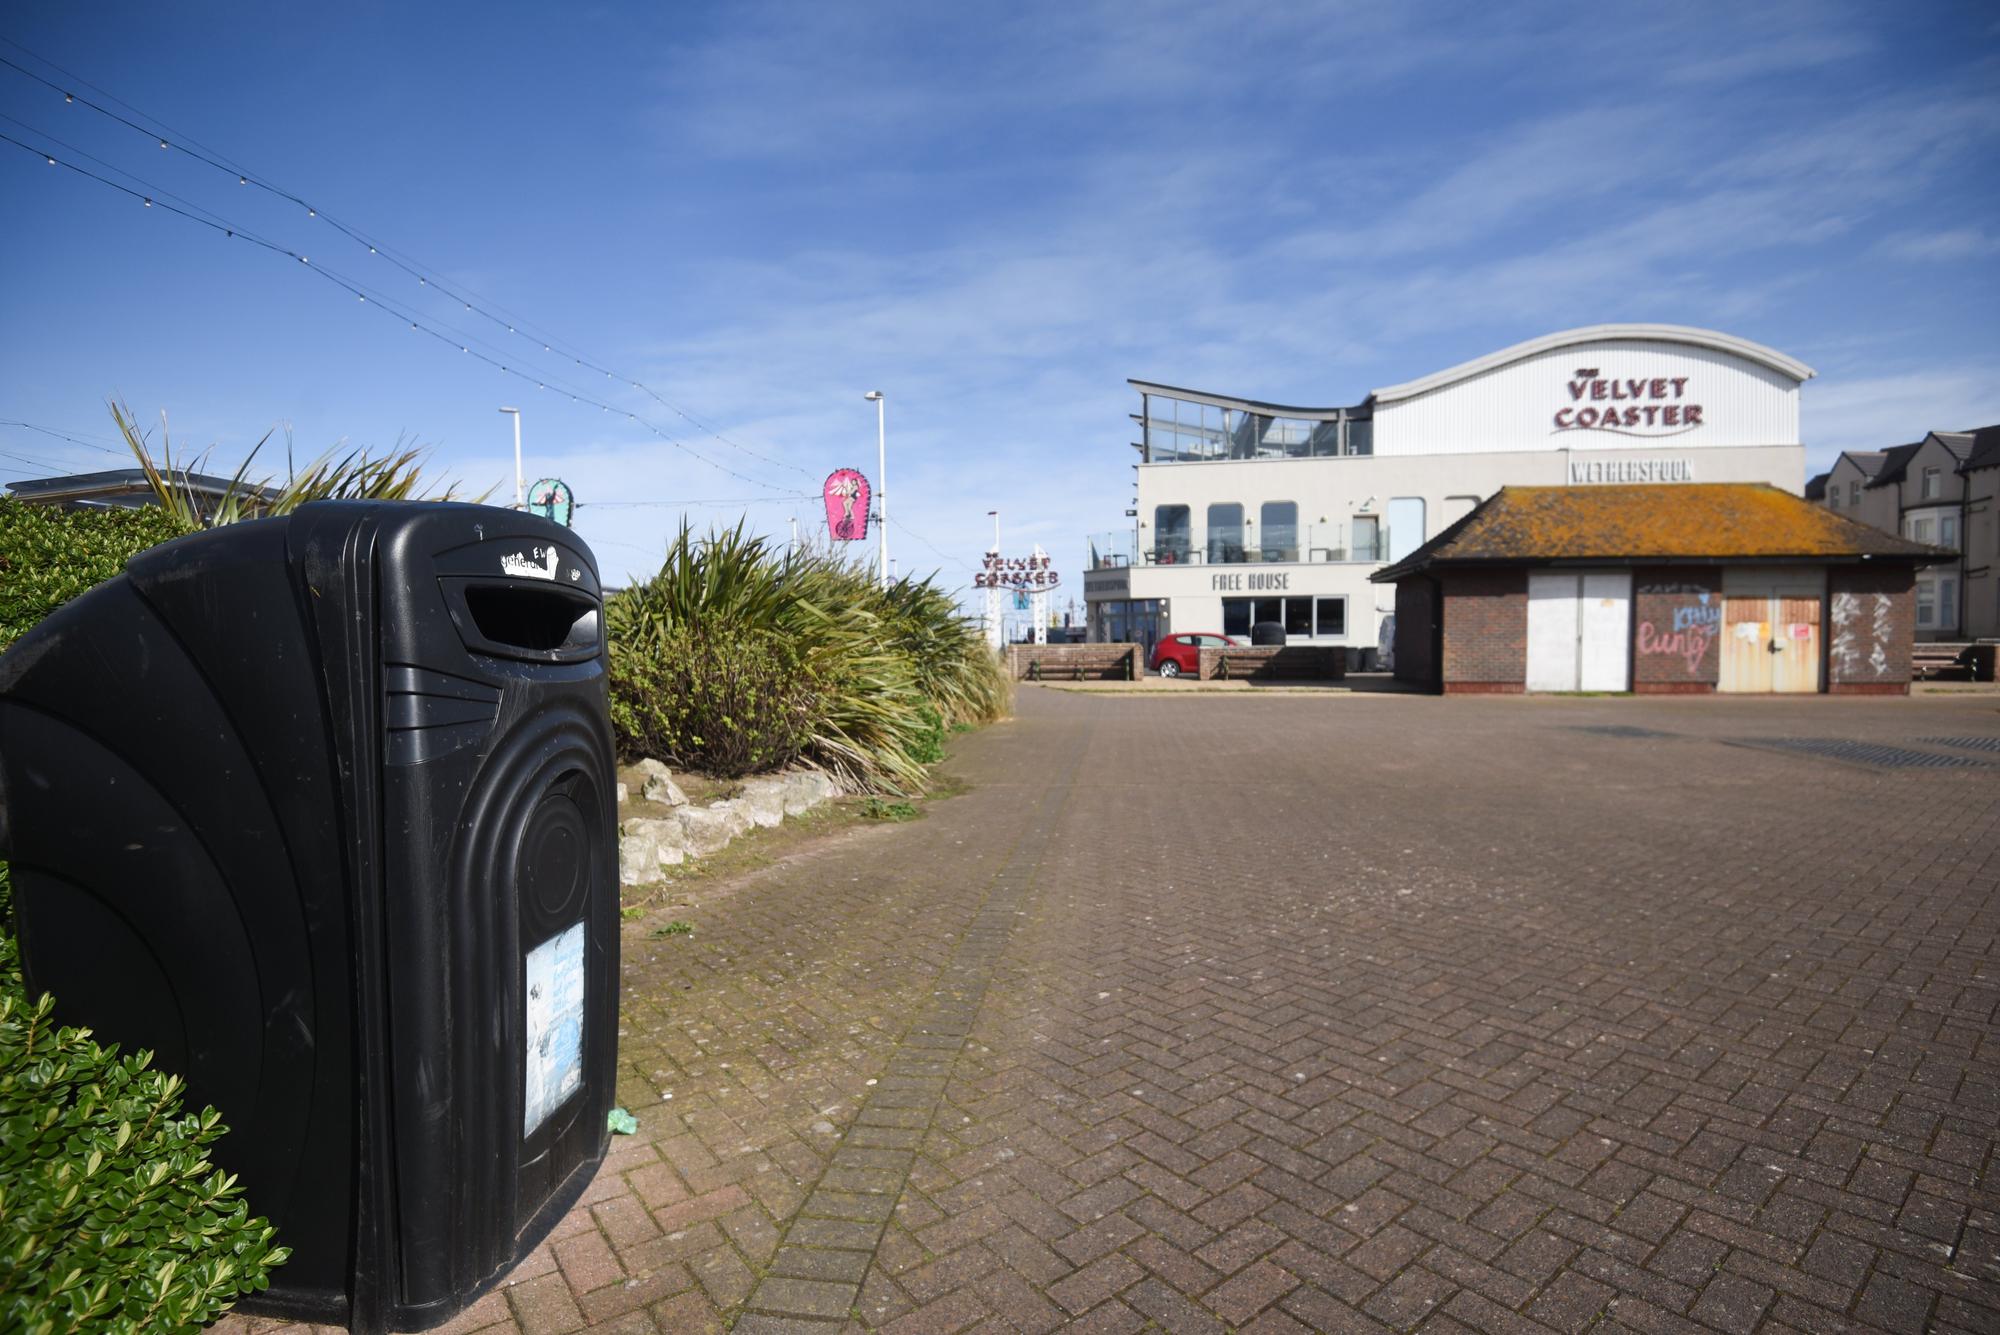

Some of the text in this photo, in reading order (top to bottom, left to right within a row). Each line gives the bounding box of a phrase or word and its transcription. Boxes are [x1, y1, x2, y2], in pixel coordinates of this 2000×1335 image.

[1568, 377, 1689, 401] VELVET
[1554, 405, 1704, 428] COASTER
[1570, 458, 1696, 484] WETHERSPOON
[982, 557, 1051, 571] VELVET
[1212, 572, 1289, 591] FREE HOUSE
